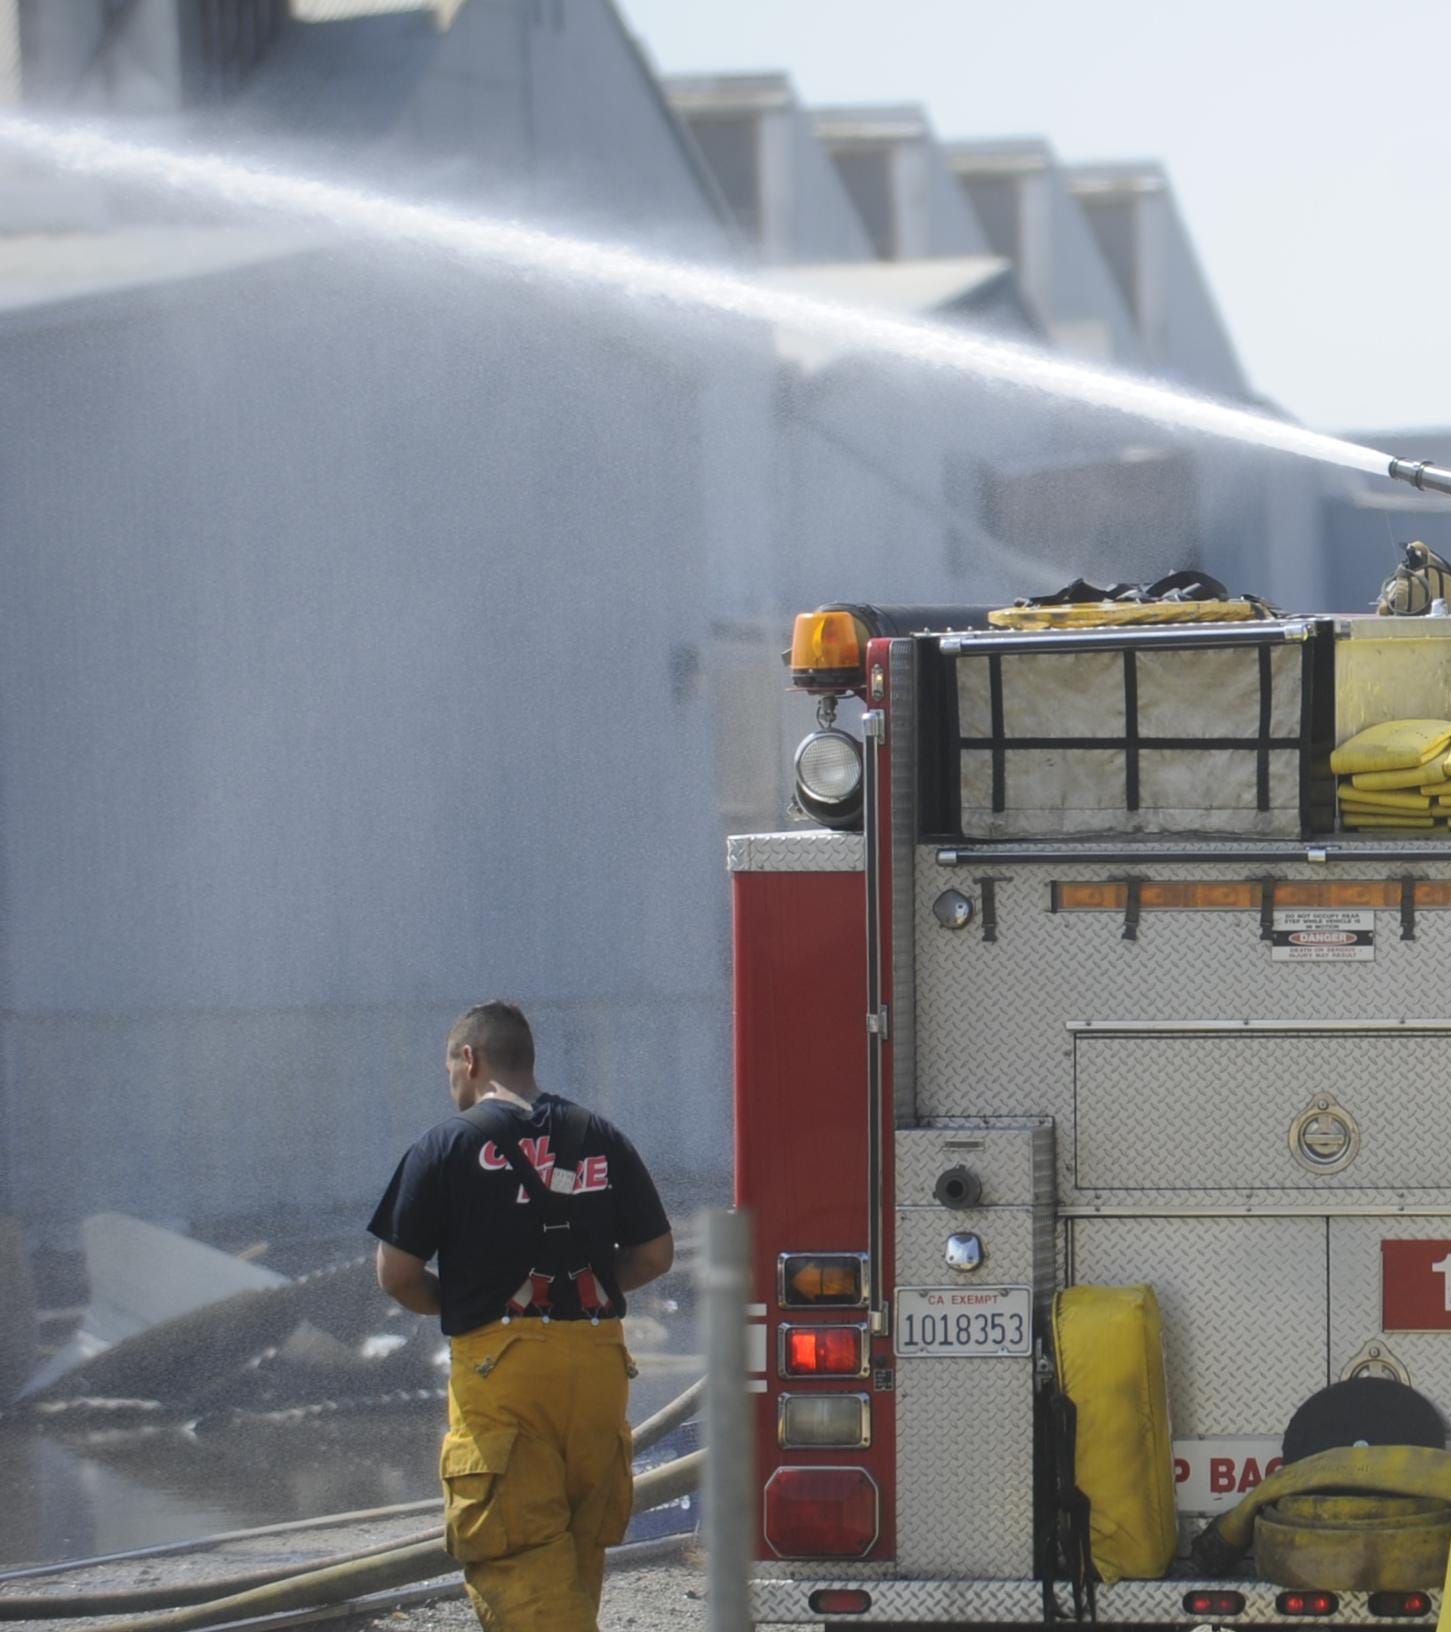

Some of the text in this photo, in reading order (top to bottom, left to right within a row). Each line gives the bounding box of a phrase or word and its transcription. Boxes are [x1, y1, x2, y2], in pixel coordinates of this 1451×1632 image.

[1300, 933, 1347, 943] DANGER
[928, 1295, 999, 1305] CA EXEMPT
[904, 1313, 1023, 1346] 1018353
